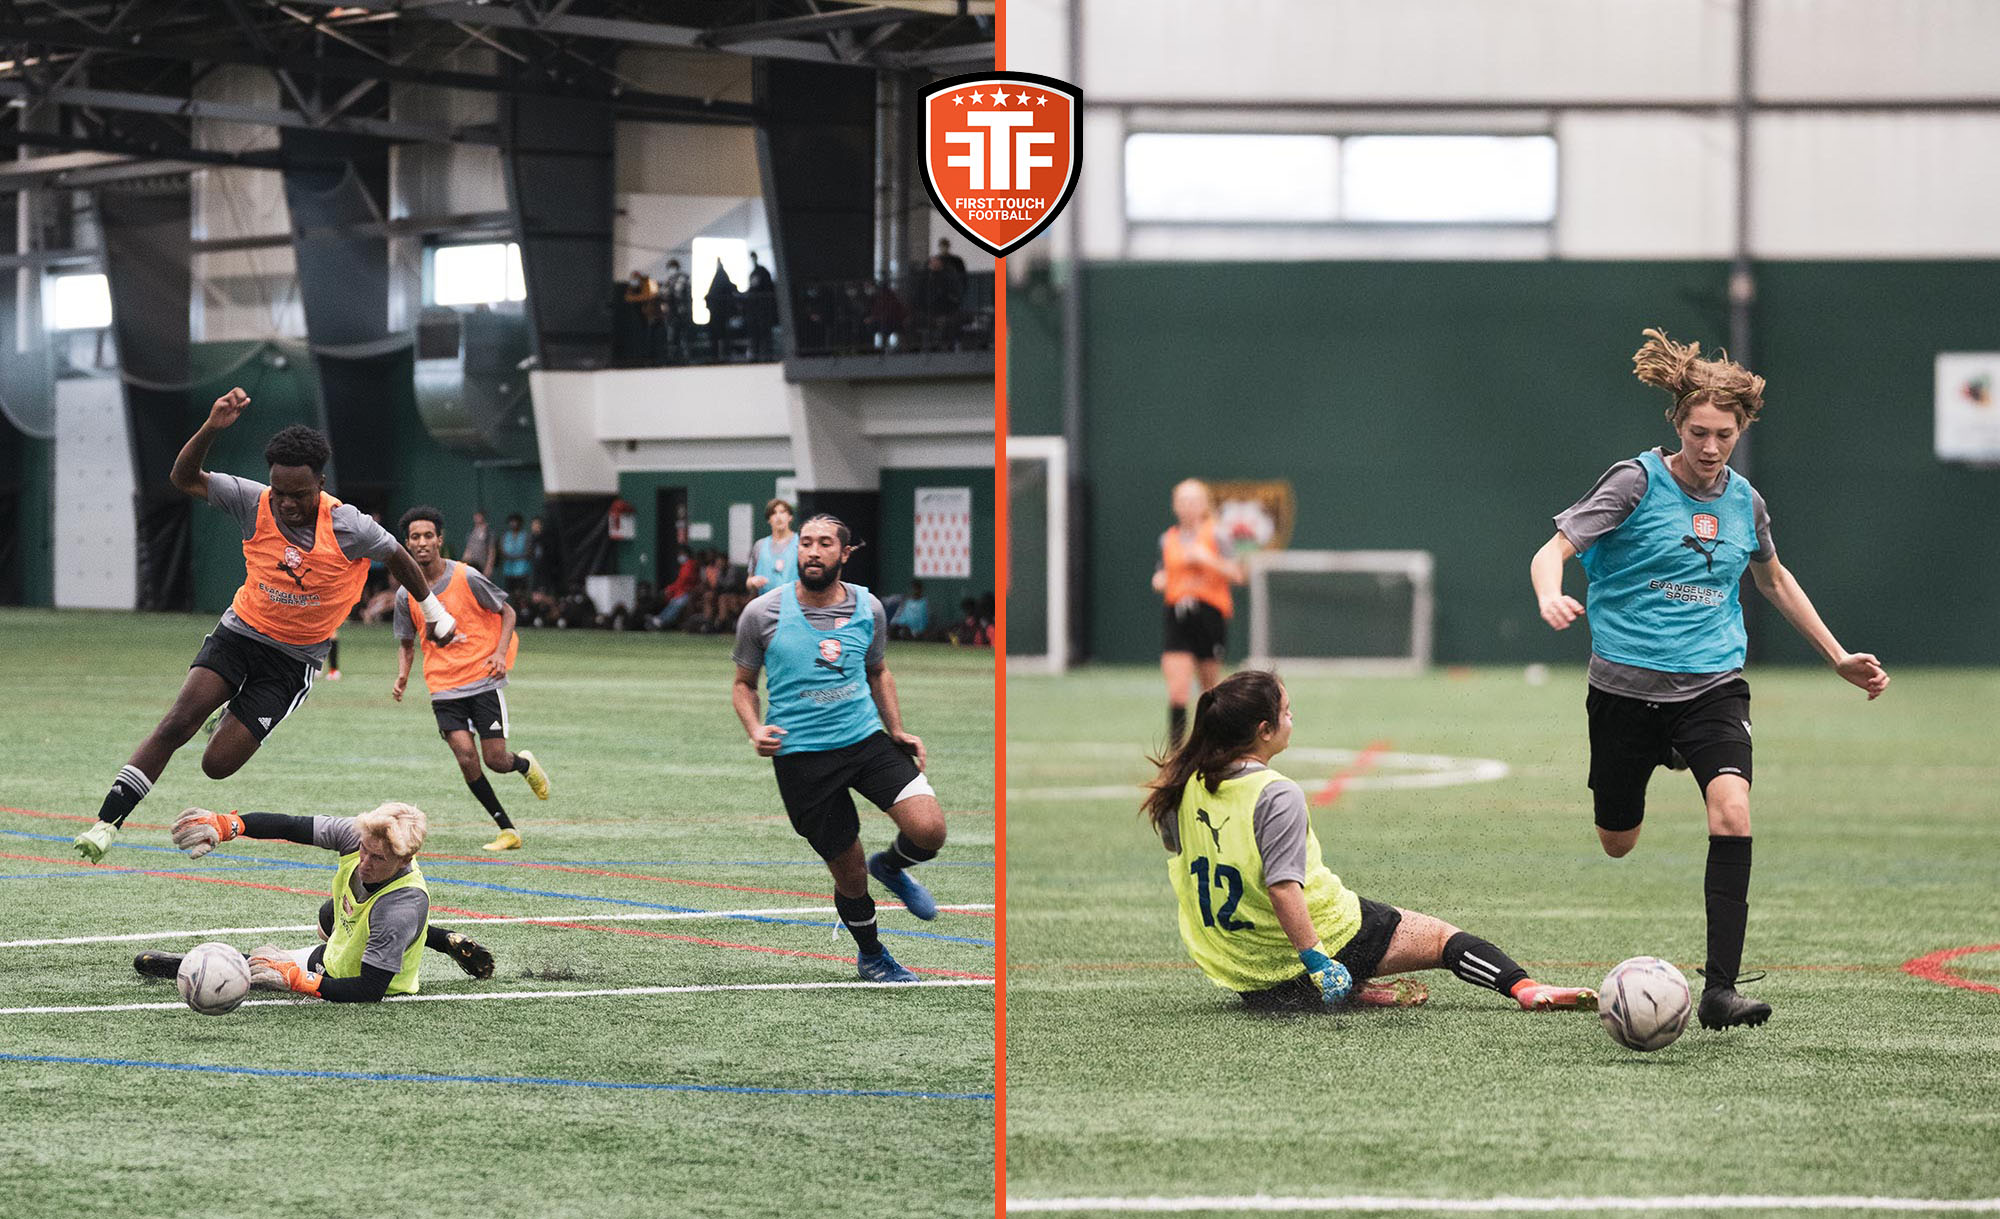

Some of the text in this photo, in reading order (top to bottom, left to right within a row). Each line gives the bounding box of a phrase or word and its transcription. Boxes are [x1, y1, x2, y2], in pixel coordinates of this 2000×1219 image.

[1650, 580, 1724, 599] EVANGELISTA
[1665, 591, 1711, 605] SPORTS
[1190, 856, 1255, 931] 12
